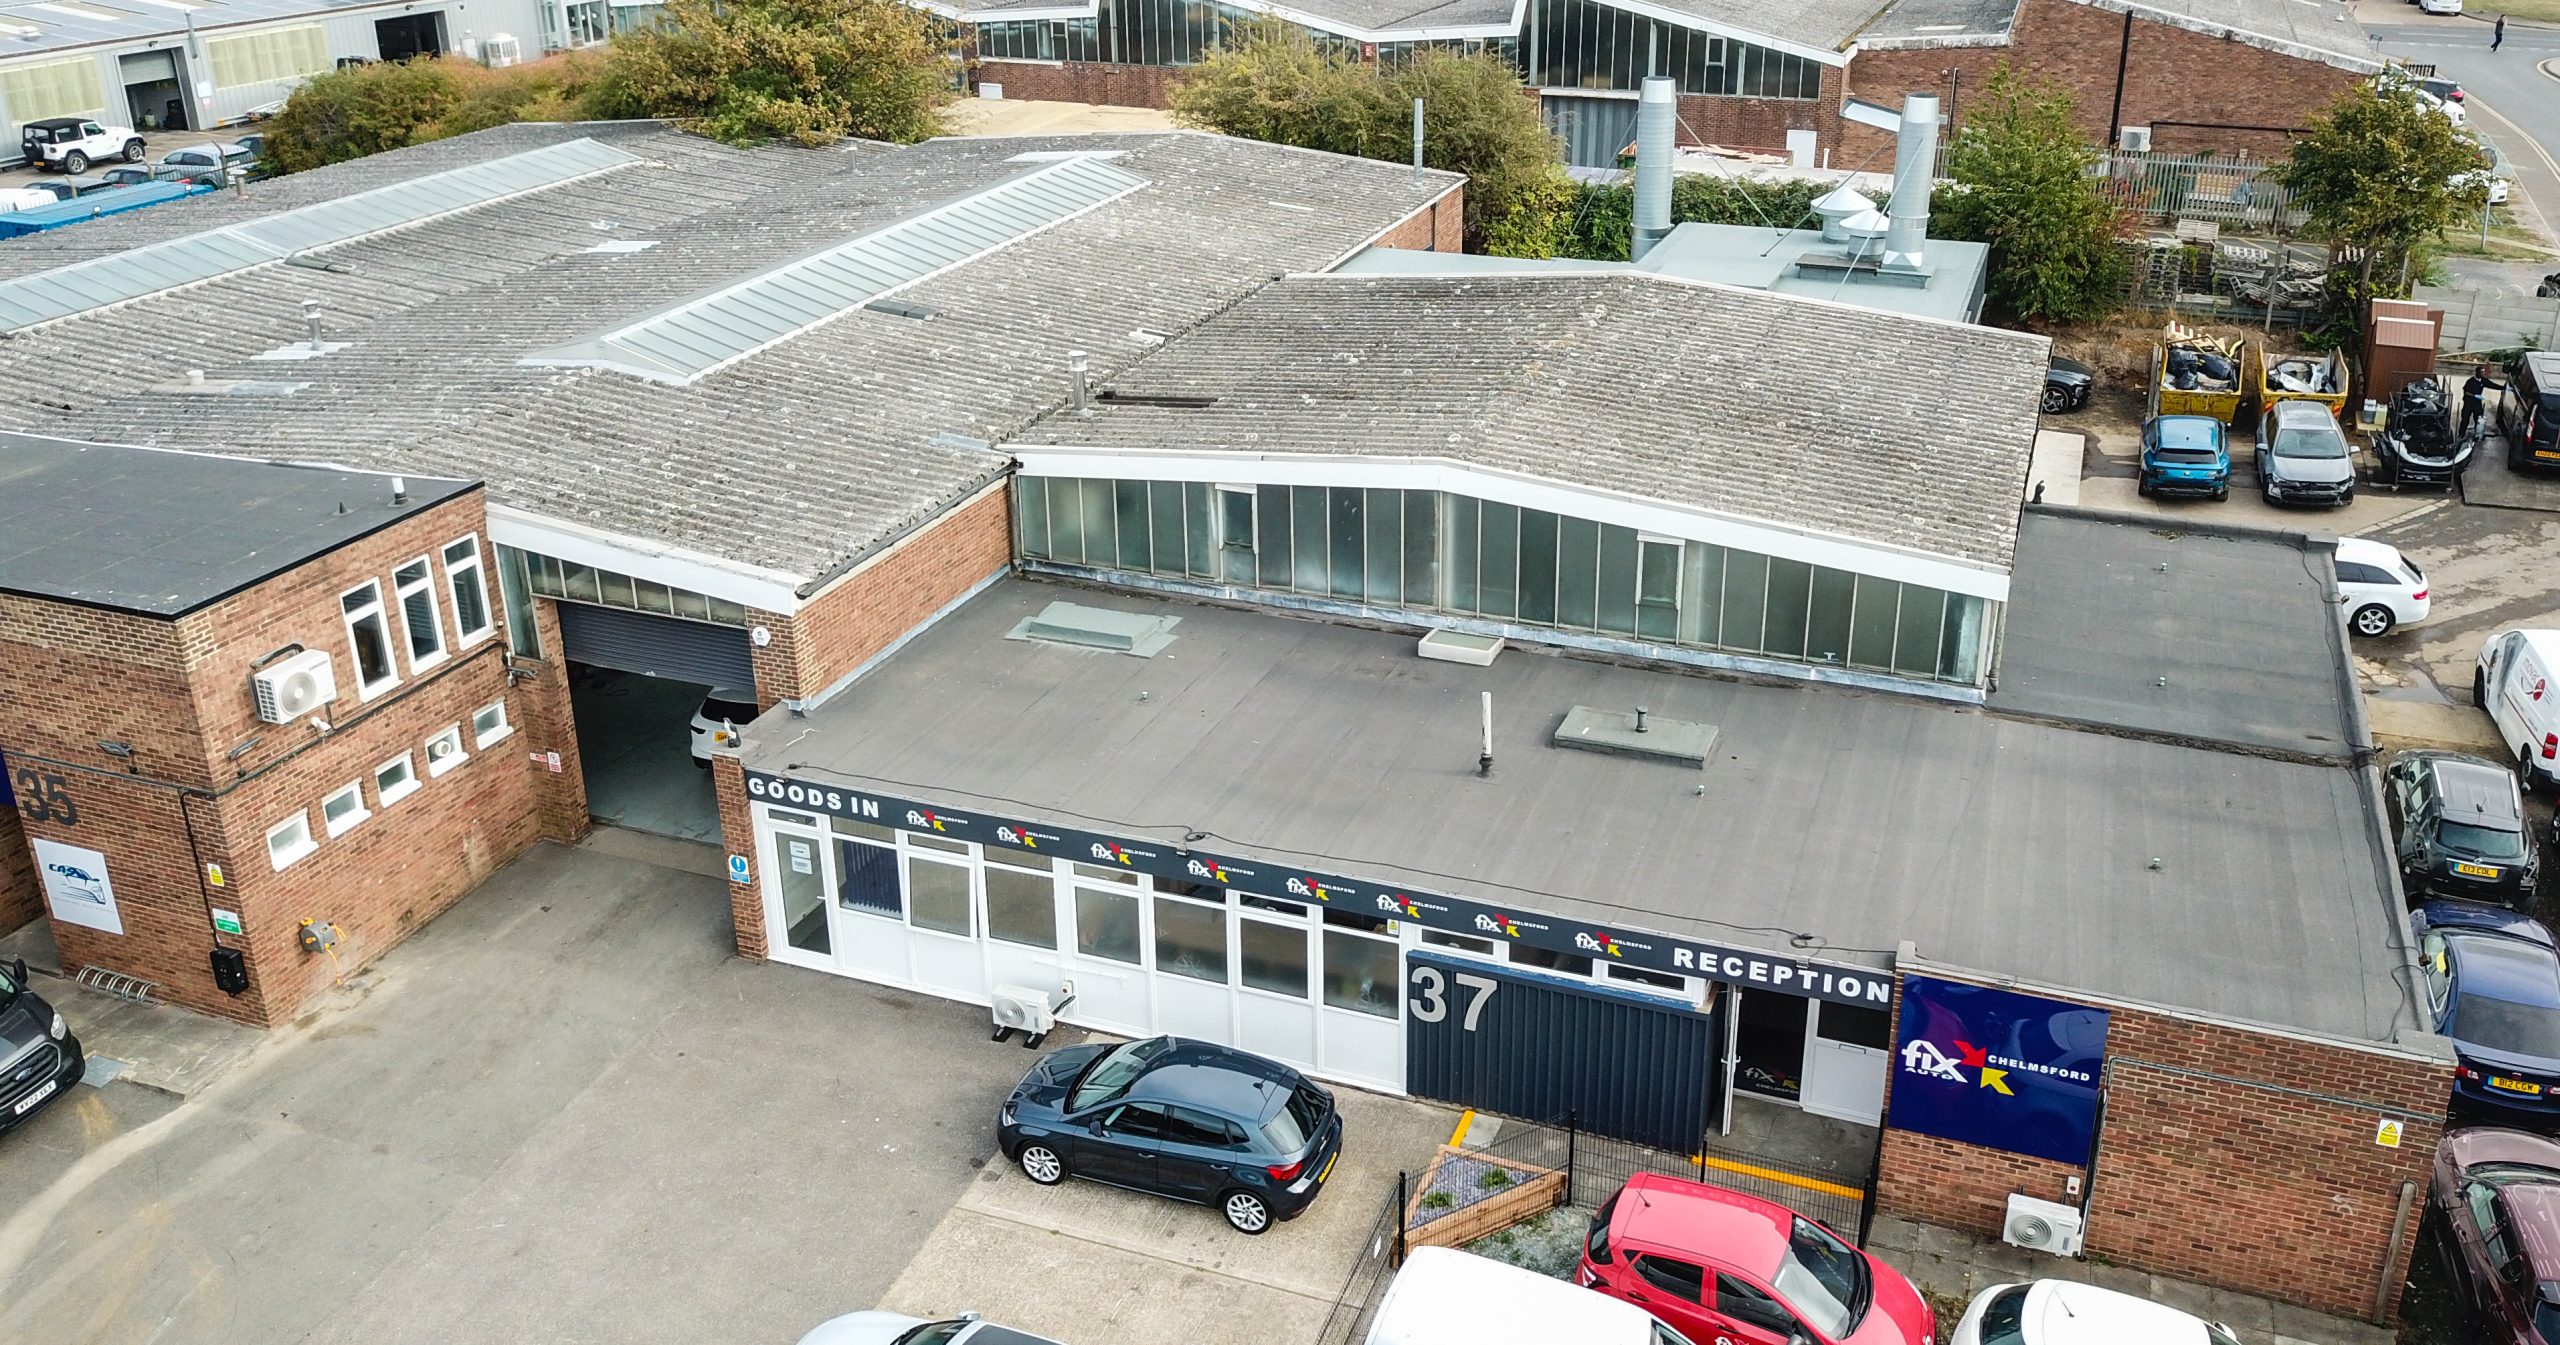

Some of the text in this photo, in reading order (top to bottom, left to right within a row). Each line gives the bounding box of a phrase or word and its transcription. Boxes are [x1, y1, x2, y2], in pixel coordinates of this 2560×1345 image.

[16, 768, 77, 826] 35
[749, 777, 879, 818] GOODS IN
[1410, 966, 1498, 1032] 37
[1673, 948, 1890, 1004] RECEPTION
[1901, 1039, 2090, 1084] fix CHELMSFORD
[1905, 1067, 1955, 1081] AUTO
